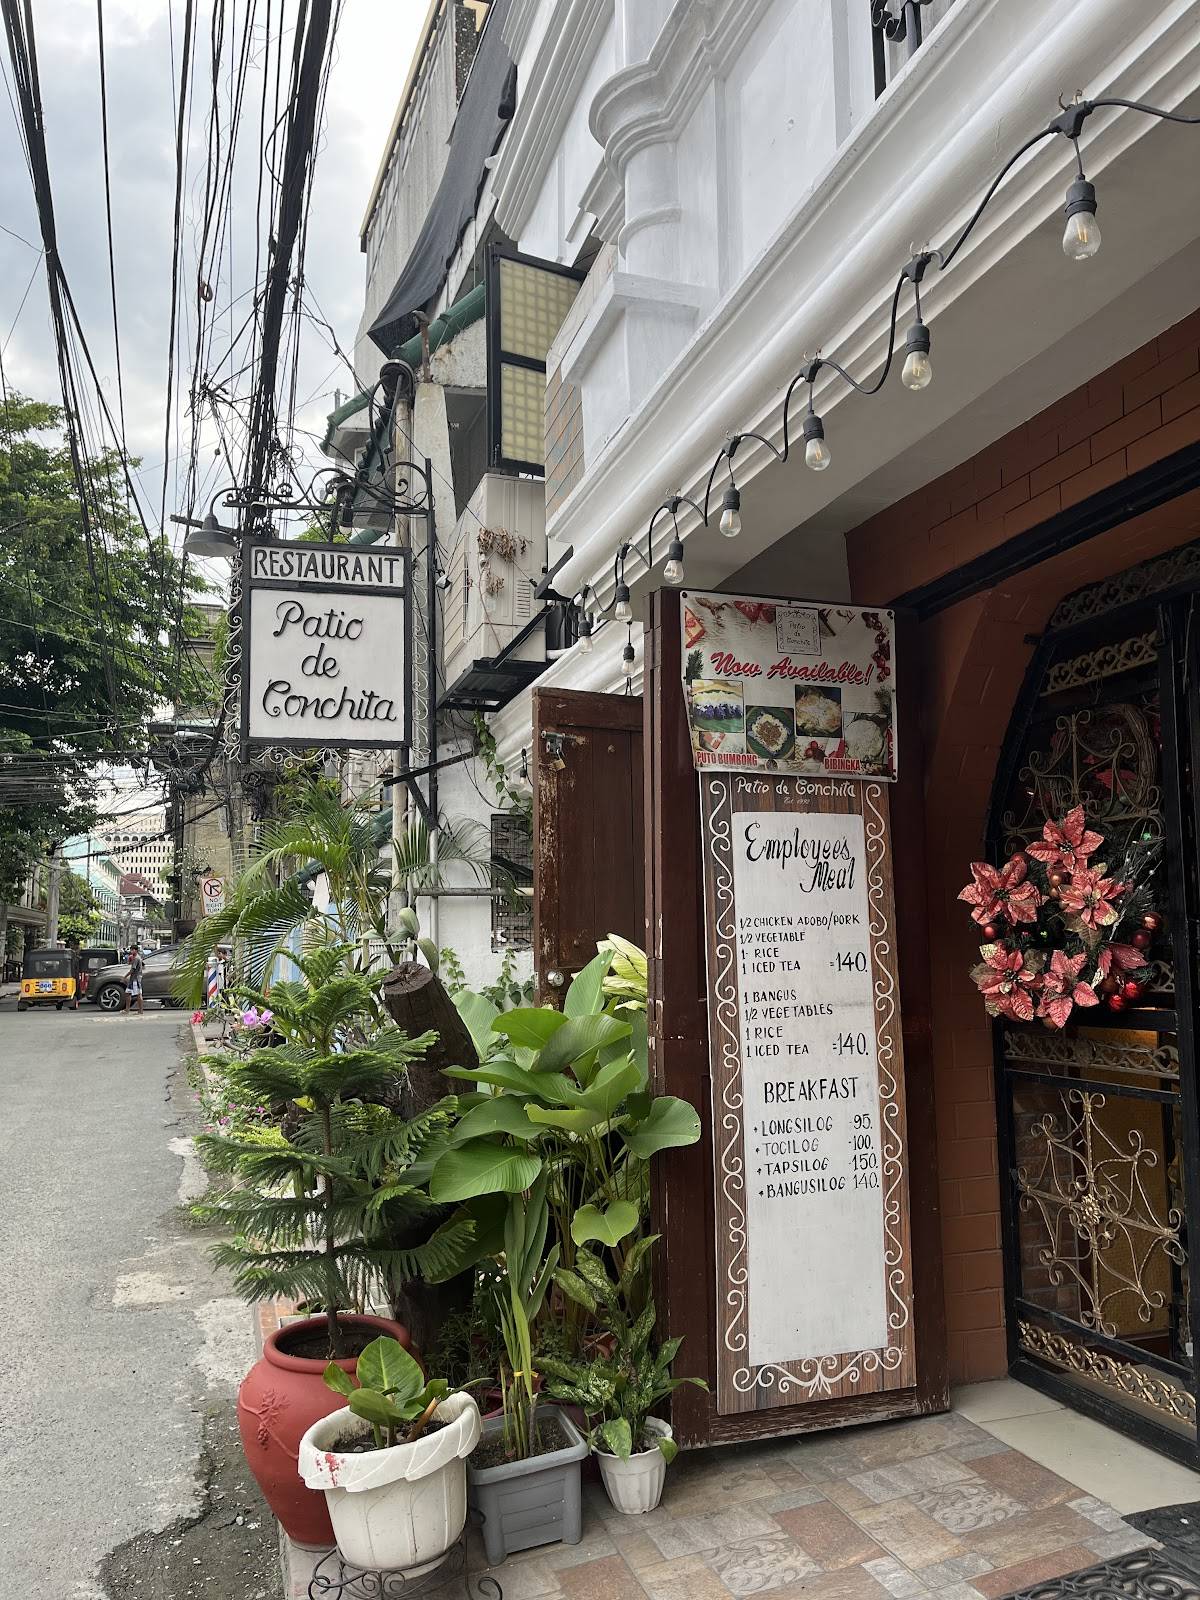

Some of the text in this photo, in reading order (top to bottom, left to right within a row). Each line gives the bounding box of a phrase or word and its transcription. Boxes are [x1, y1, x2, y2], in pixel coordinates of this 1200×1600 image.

[254, 549, 399, 584] RESTAURANT
[273, 600, 364, 640] Patio
[301, 643, 340, 678] de
[710, 651, 874, 685] Now Available!
[262, 679, 398, 722] Conchita
[696, 752, 861, 771] PUTO BUMBONG BIBINGKA
[736, 776, 856, 797] Patio de Conchita
[800, 857, 855, 893] Meal
[754, 916, 793, 928] CHICKEN
[755, 932, 806, 943] VEGETABLE
[754, 948, 779, 958] RICE
[752, 962, 775, 973] ICED
[780, 960, 801, 971] TEA
[753, 990, 797, 1002] BANGUS
[745, 1004, 833, 1022] 1/2 VEGETABLES
[754, 1026, 783, 1039] RICE
[755, 1045, 780, 1056] ICED
[786, 1044, 809, 1055] TEA
[764, 1077, 858, 1103] BREAKFAST
[762, 1116, 833, 1136] LONGSILOG
[762, 1138, 819, 1156] TOCILOG
[764, 1157, 830, 1176] TAPSILOG
[767, 1176, 846, 1198] BANGUSILOG
